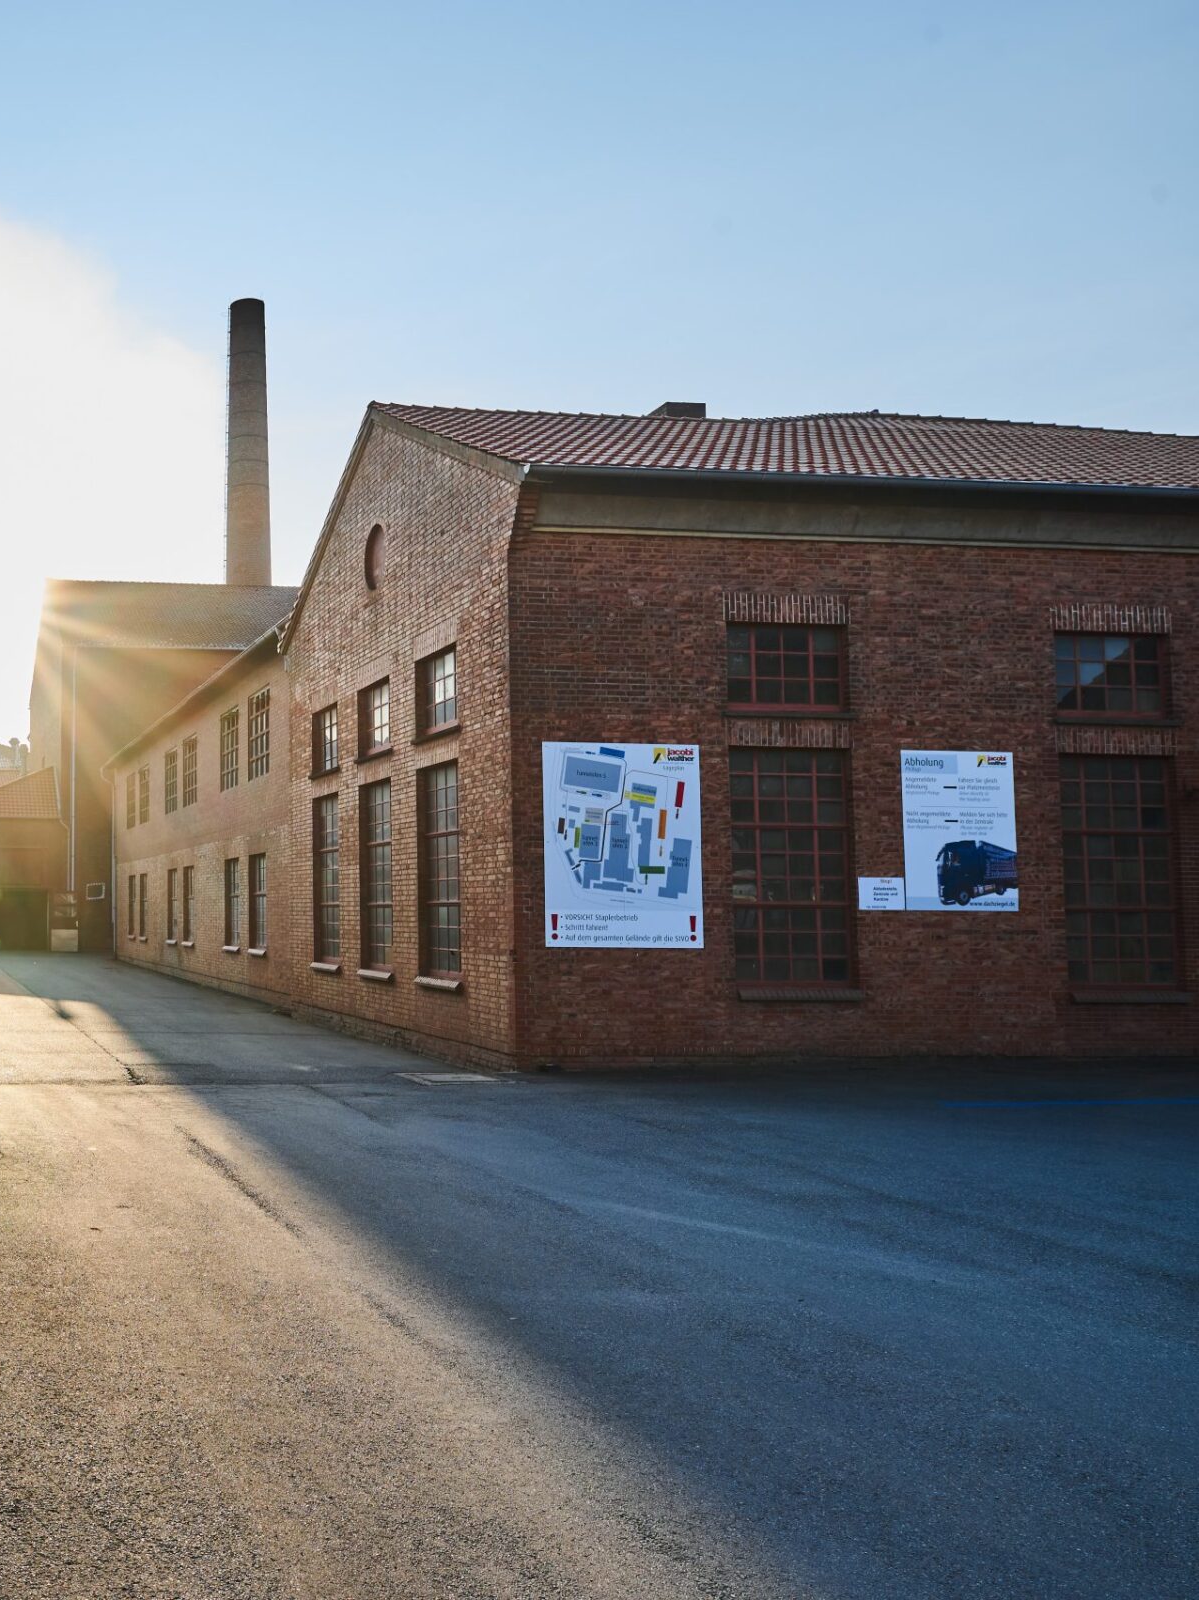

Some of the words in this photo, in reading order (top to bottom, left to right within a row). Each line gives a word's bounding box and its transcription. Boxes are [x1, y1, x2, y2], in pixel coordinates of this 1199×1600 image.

[667, 748, 694, 757] jacobi
[905, 758, 944, 769] Abholung
[595, 914, 638, 922] Staplerbetrieb
[593, 935, 623, 943] gesamten
[625, 934, 650, 942] Gelände
[652, 935, 662, 943] gilt
